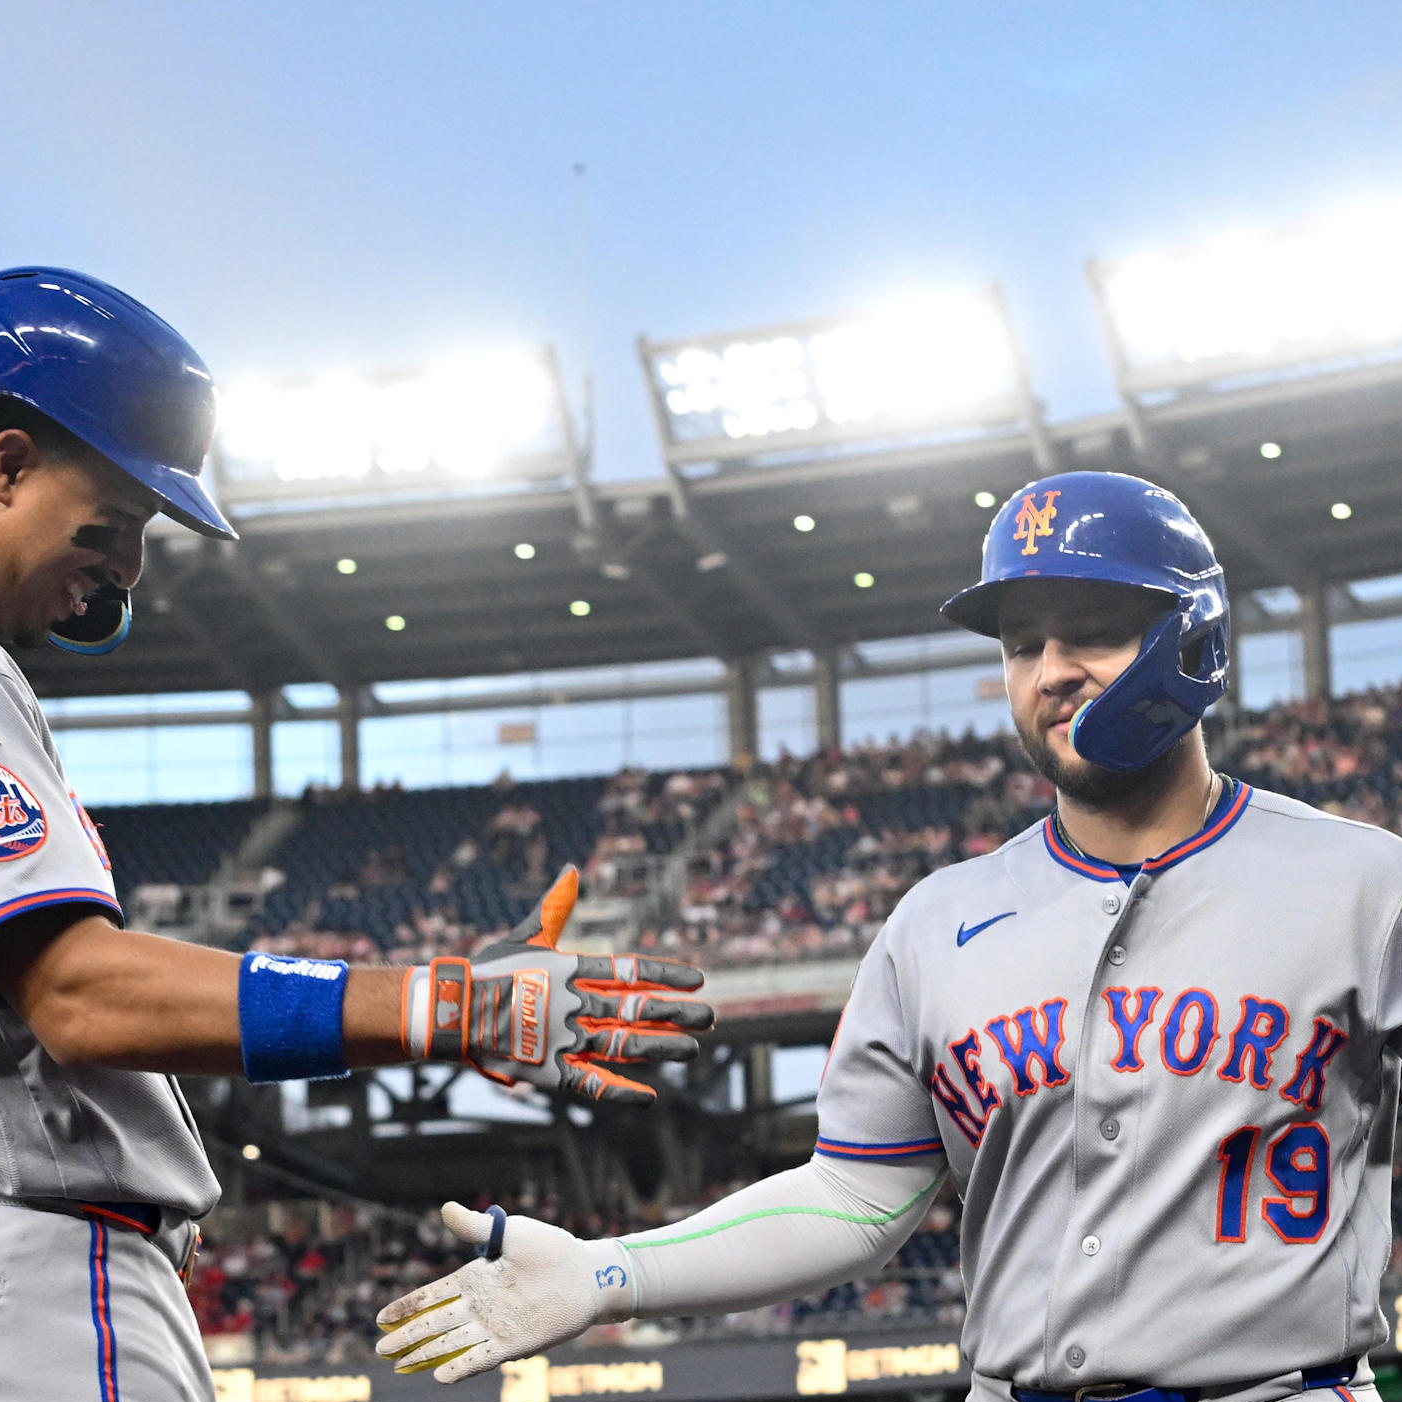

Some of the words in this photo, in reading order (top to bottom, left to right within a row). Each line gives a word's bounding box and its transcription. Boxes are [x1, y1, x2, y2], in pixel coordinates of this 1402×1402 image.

[1013, 490, 1061, 556] NY
[931, 997, 1070, 1150] NEW
[1102, 985, 1349, 1112] YORK
[1215, 1120, 1331, 1245] 19
